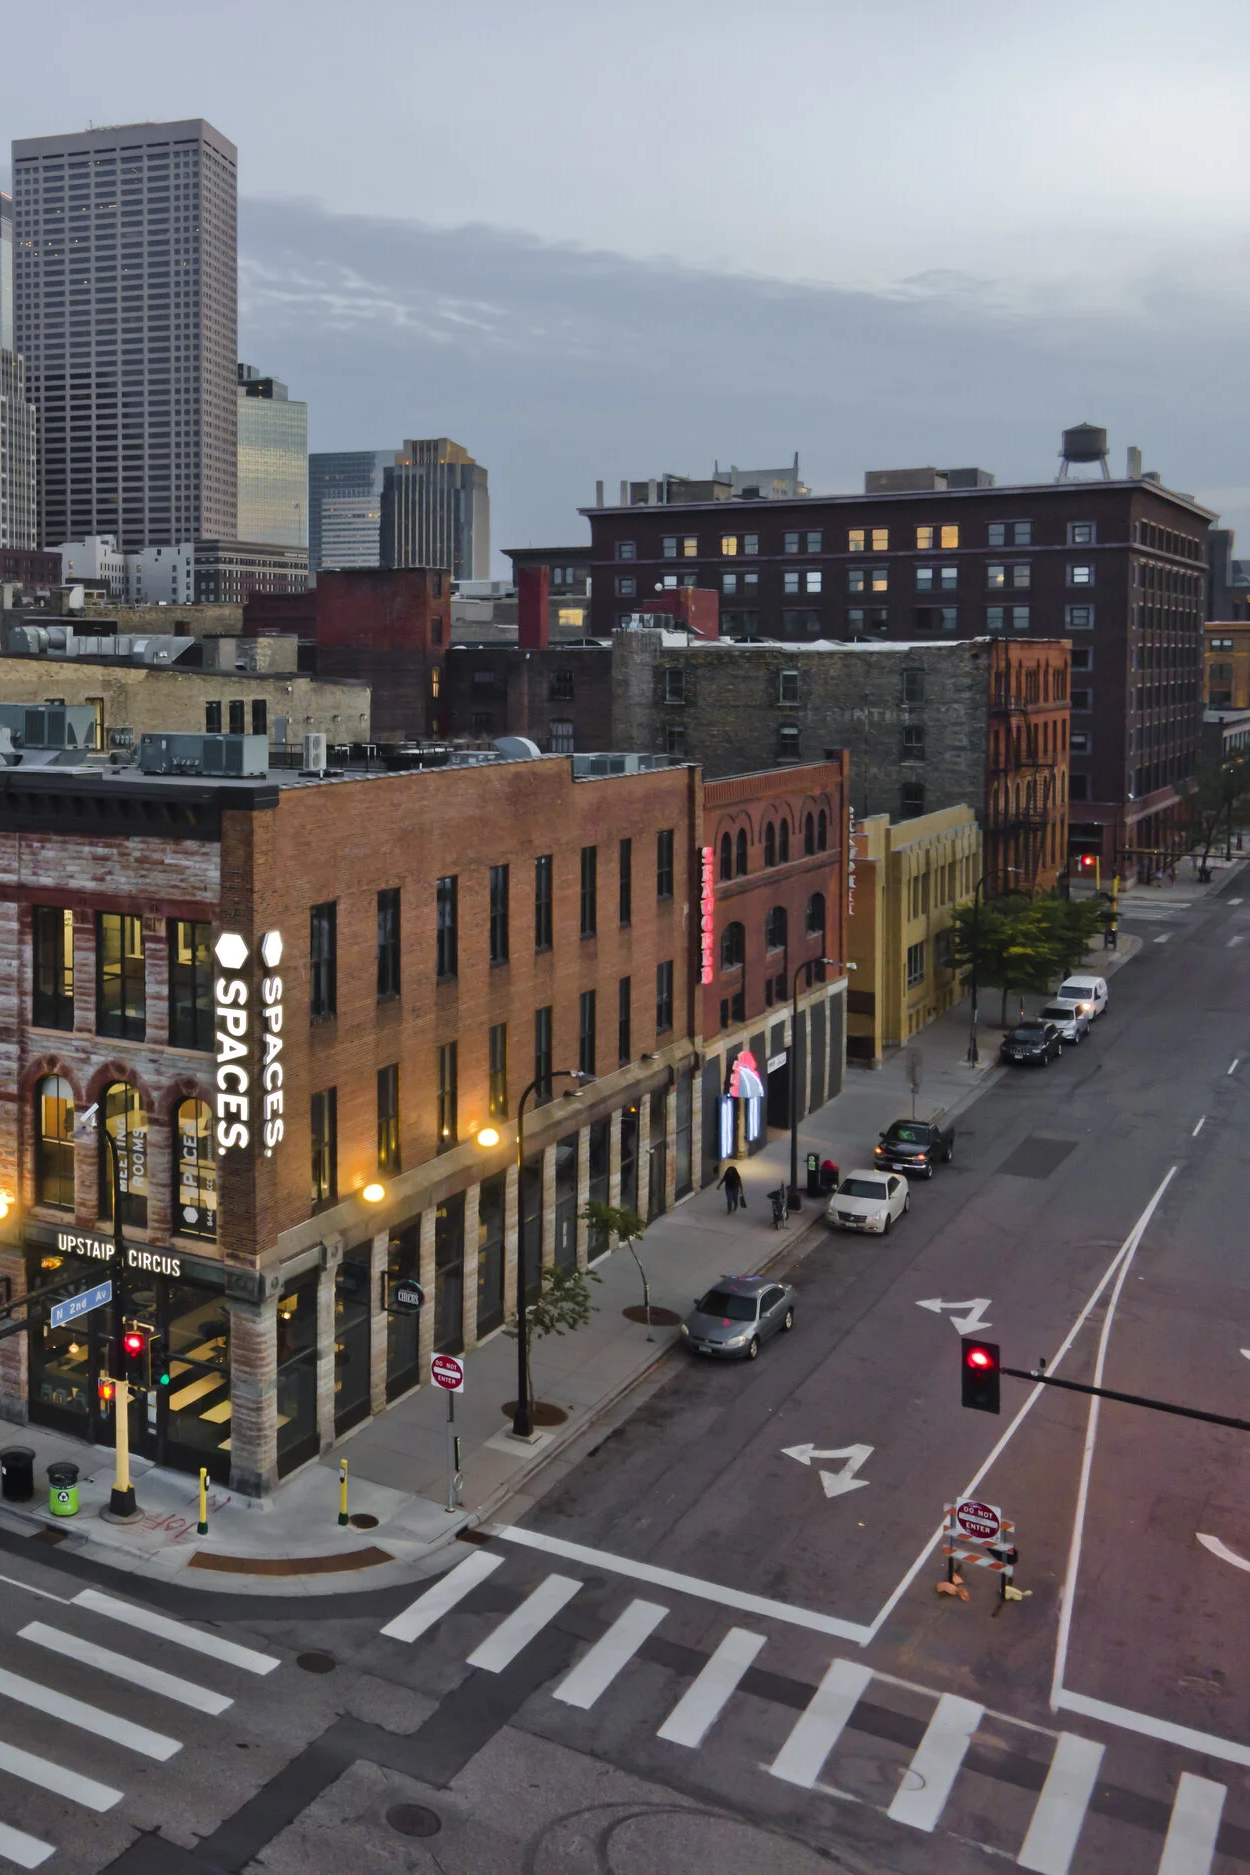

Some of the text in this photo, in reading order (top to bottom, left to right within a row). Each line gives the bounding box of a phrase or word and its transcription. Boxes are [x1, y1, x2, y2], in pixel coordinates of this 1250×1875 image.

[133, 1128, 145, 1188] ROOMS
[58, 1233, 182, 1277] UPSTAIR CIRCUS
[56, 1289, 107, 1321] N 2nd Av
[438, 1375, 456, 1385] ENTER
[978, 1510, 993, 1519] NOT
[966, 1522, 991, 1534] ENTER
